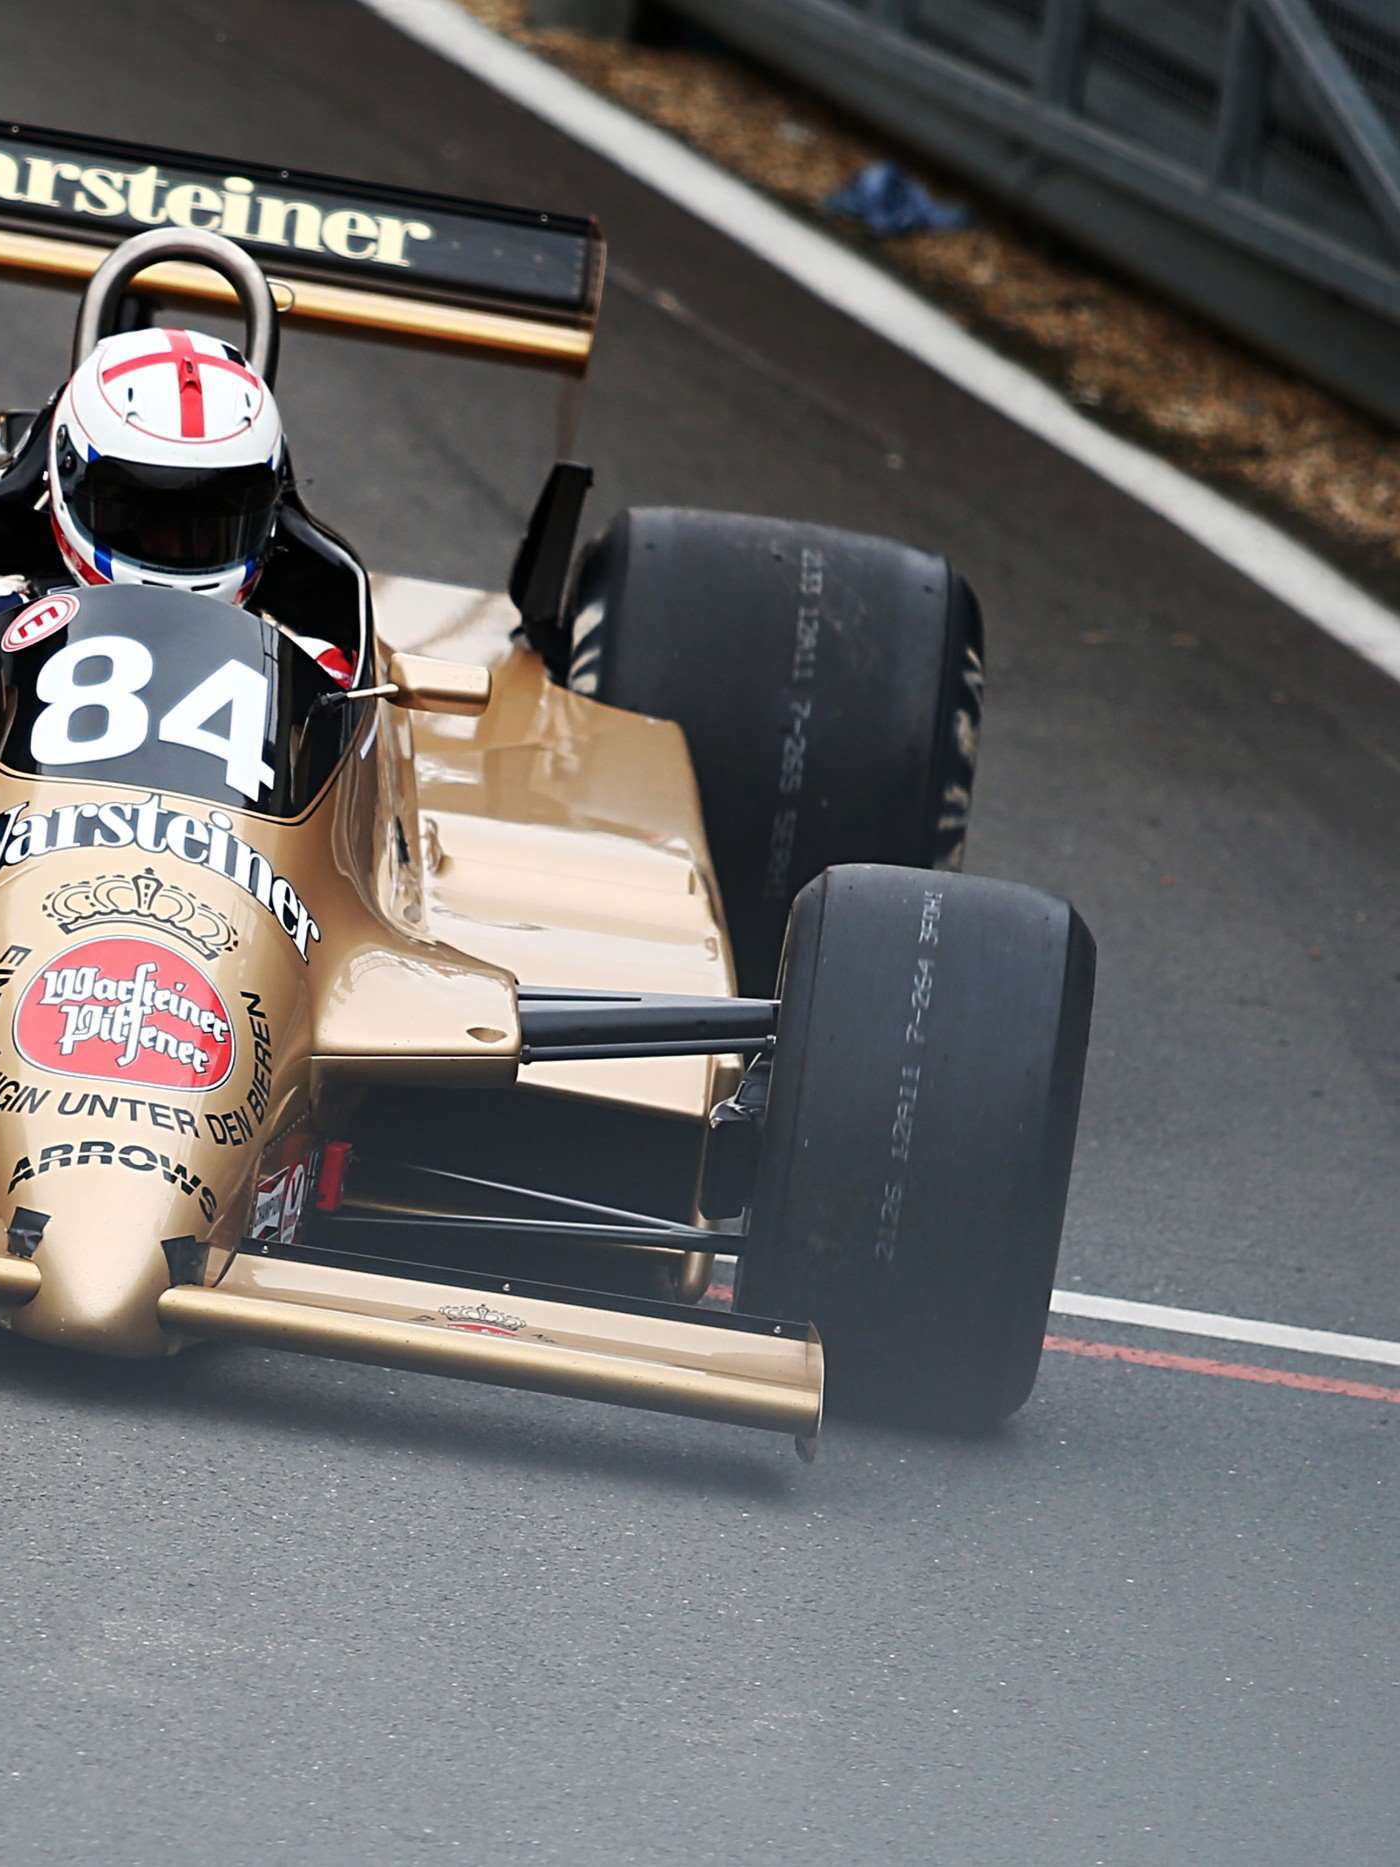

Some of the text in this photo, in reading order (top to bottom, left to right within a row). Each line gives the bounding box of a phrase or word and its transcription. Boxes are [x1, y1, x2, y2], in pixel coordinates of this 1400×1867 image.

[30, 635, 275, 803] 84
[56, 1091, 202, 1139] UNTER
[203, 1107, 253, 1147] DEN
[240, 991, 274, 1127] BIEREN
[7, 1140, 219, 1224] ARROWS
